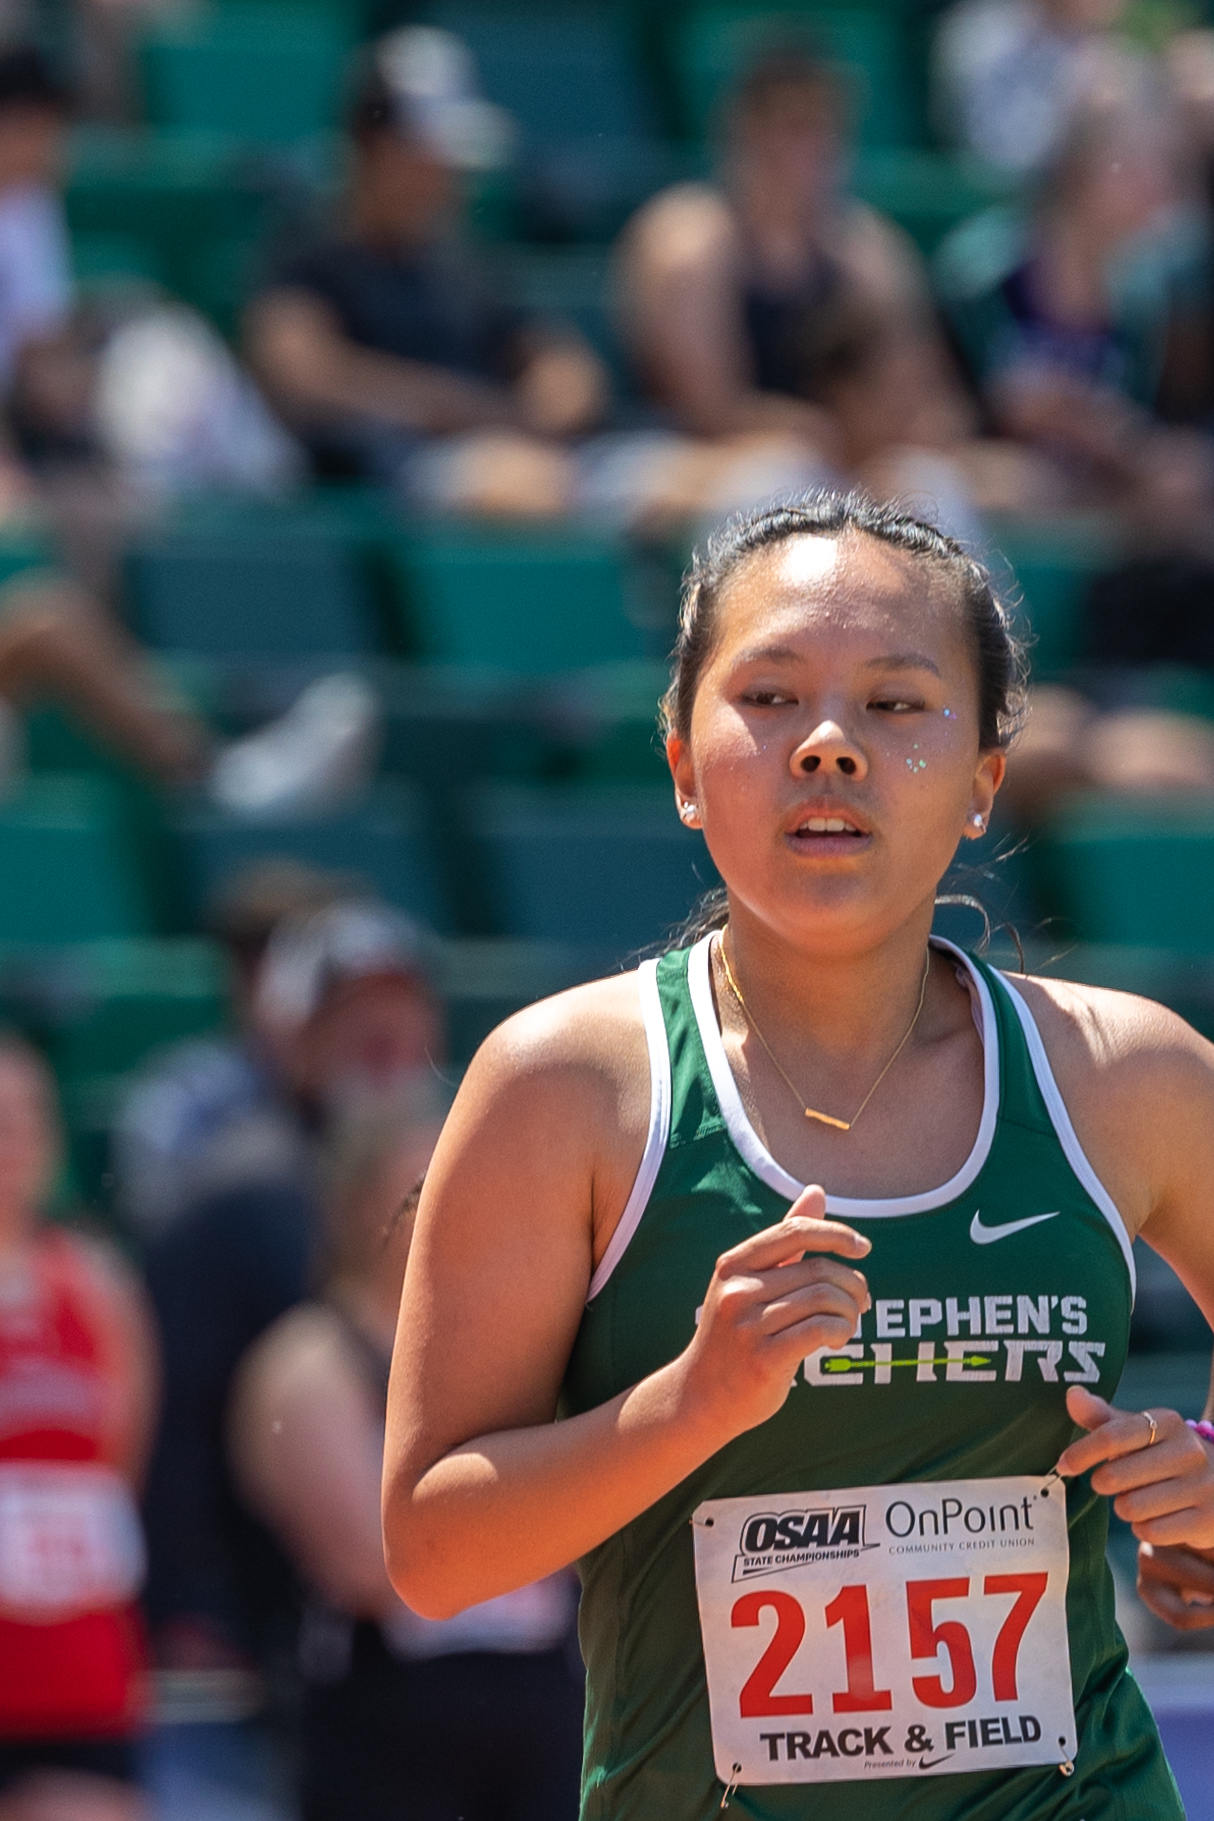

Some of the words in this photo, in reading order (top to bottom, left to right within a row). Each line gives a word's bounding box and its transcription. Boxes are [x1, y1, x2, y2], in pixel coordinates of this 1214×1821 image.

[853, 1295, 1088, 1338] EPHEN'S
[791, 1340, 1106, 1386] CHERS
[743, 1510, 862, 1552] OSAA
[885, 1497, 1034, 1538] OnPoint
[743, 1556, 773, 1567] STATE
[775, 1549, 860, 1564] CHAMPIONSHIPS
[888, 1543, 954, 1555] COMMUNITY
[959, 1540, 996, 1551] CREDIT
[1000, 1537, 1035, 1548] UNION
[731, 1571, 1049, 1718] 2157
[760, 1726, 893, 1761] TRACK
[904, 1724, 934, 1752] &
[945, 1715, 1041, 1750] FIELD
